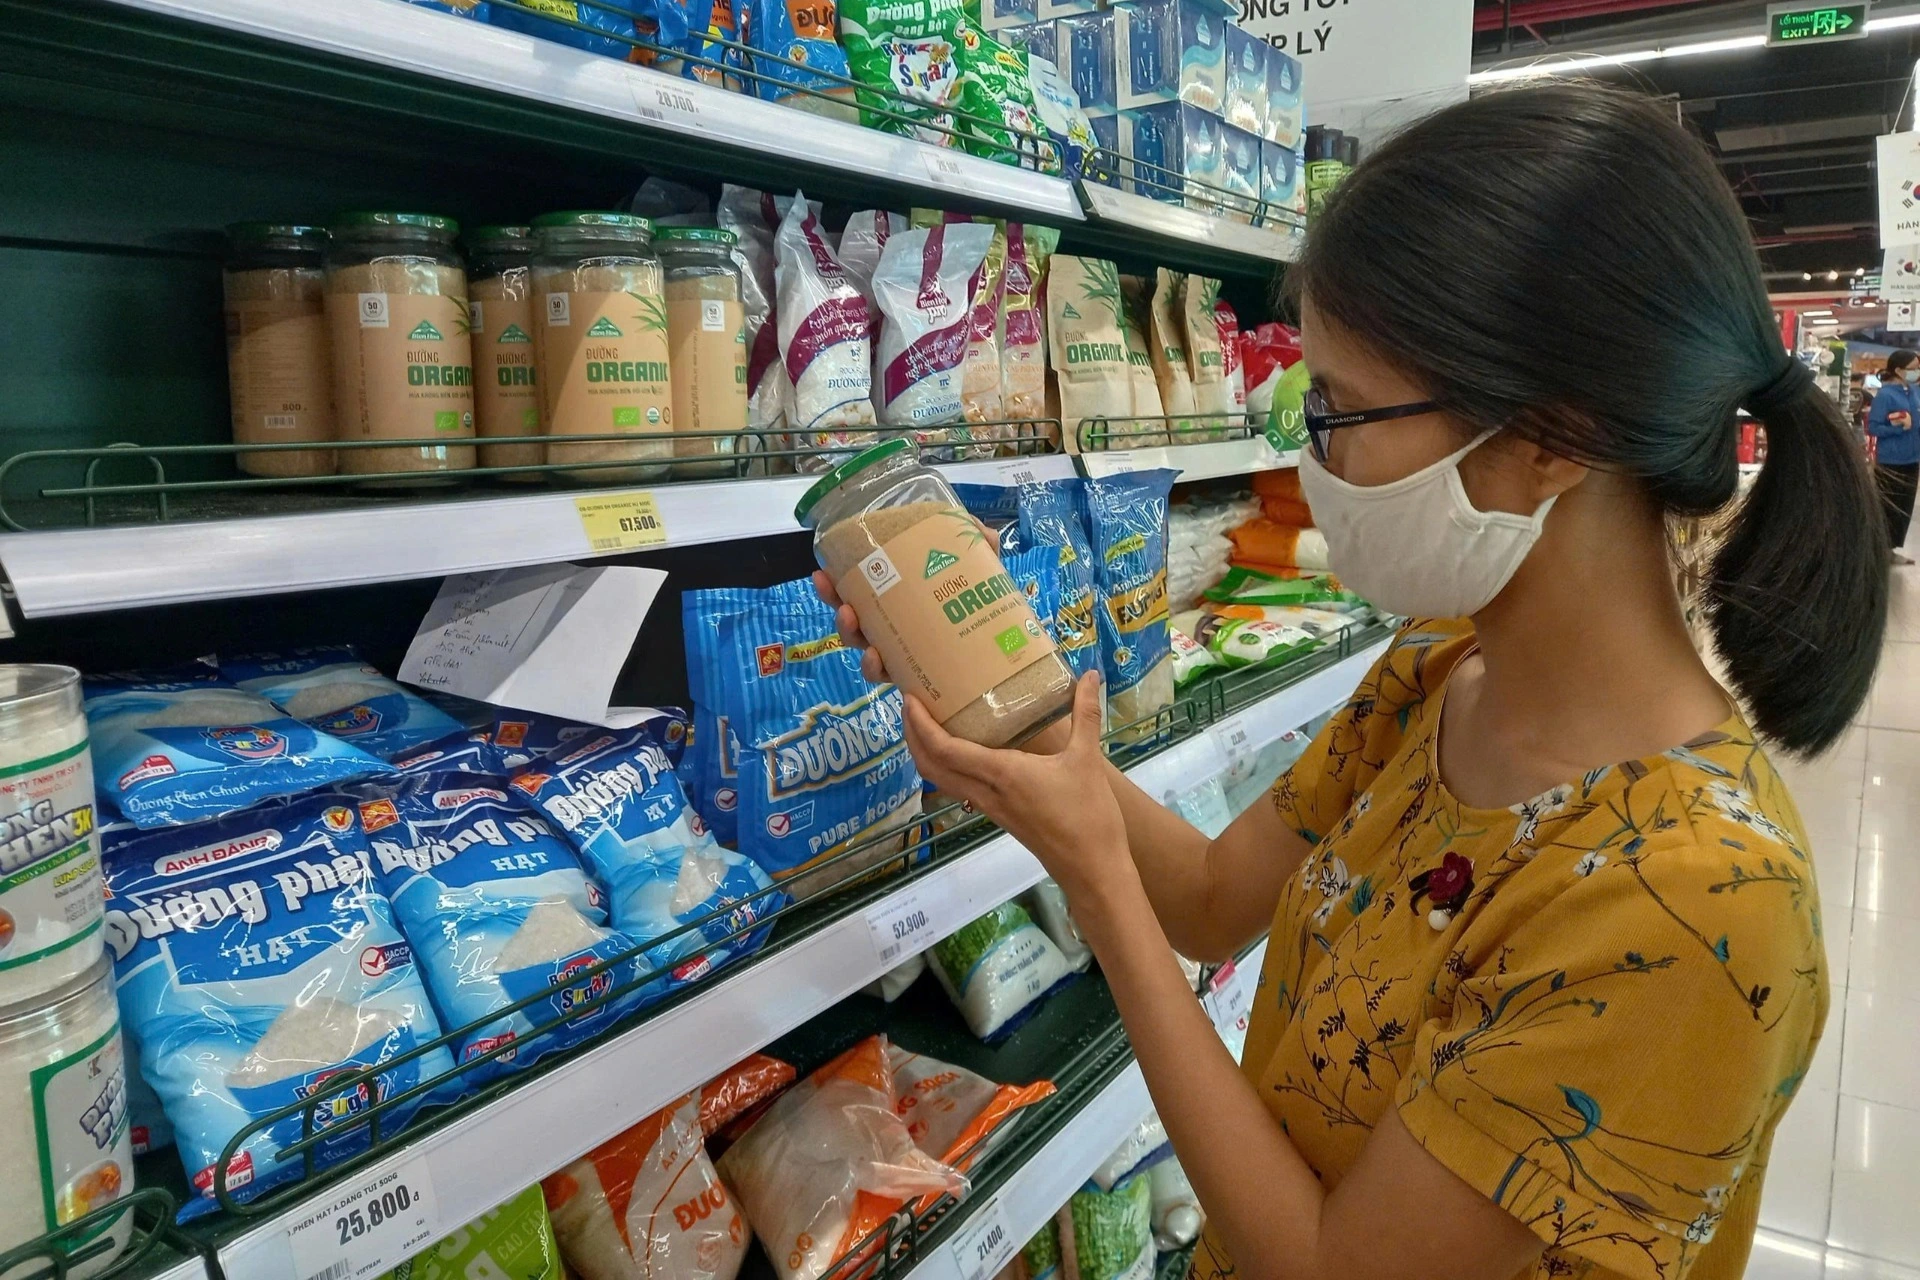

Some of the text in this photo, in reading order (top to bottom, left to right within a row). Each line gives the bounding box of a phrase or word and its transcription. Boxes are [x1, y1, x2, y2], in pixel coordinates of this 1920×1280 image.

[1296, 20, 1333, 55] LÝ
[1781, 27, 1810, 39] EXIT
[368, 302, 378, 310] 50
[1066, 342, 1126, 364] ORGANIC
[1325, 414, 1365, 426] DIAMOND
[619, 515, 657, 532] 67,500
[870, 562, 882, 574] 50
[933, 574, 969, 603] ĐƯỜNG
[73, 807, 92, 837] 3K
[790, 809, 811, 822] HACCP
[808, 788, 907, 854] PURE ROCK
[165, 836, 268, 874] ANH ĐĂNG
[490, 851, 549, 872] HẠT
[892, 909, 927, 940] 52,900
[236, 927, 312, 965] HẠT
[384, 946, 410, 959] HACCP
[560, 970, 609, 1011] Sugar
[316, 1207, 332, 1221] HAT
[333, 1191, 363, 1213] A.DANG
[363, 1182, 378, 1195] TUI
[379, 1171, 399, 1187] 500G
[335, 1184, 411, 1247] 25,800
[498, 1233, 523, 1260] CAO
[977, 1224, 1003, 1262] 21,400
